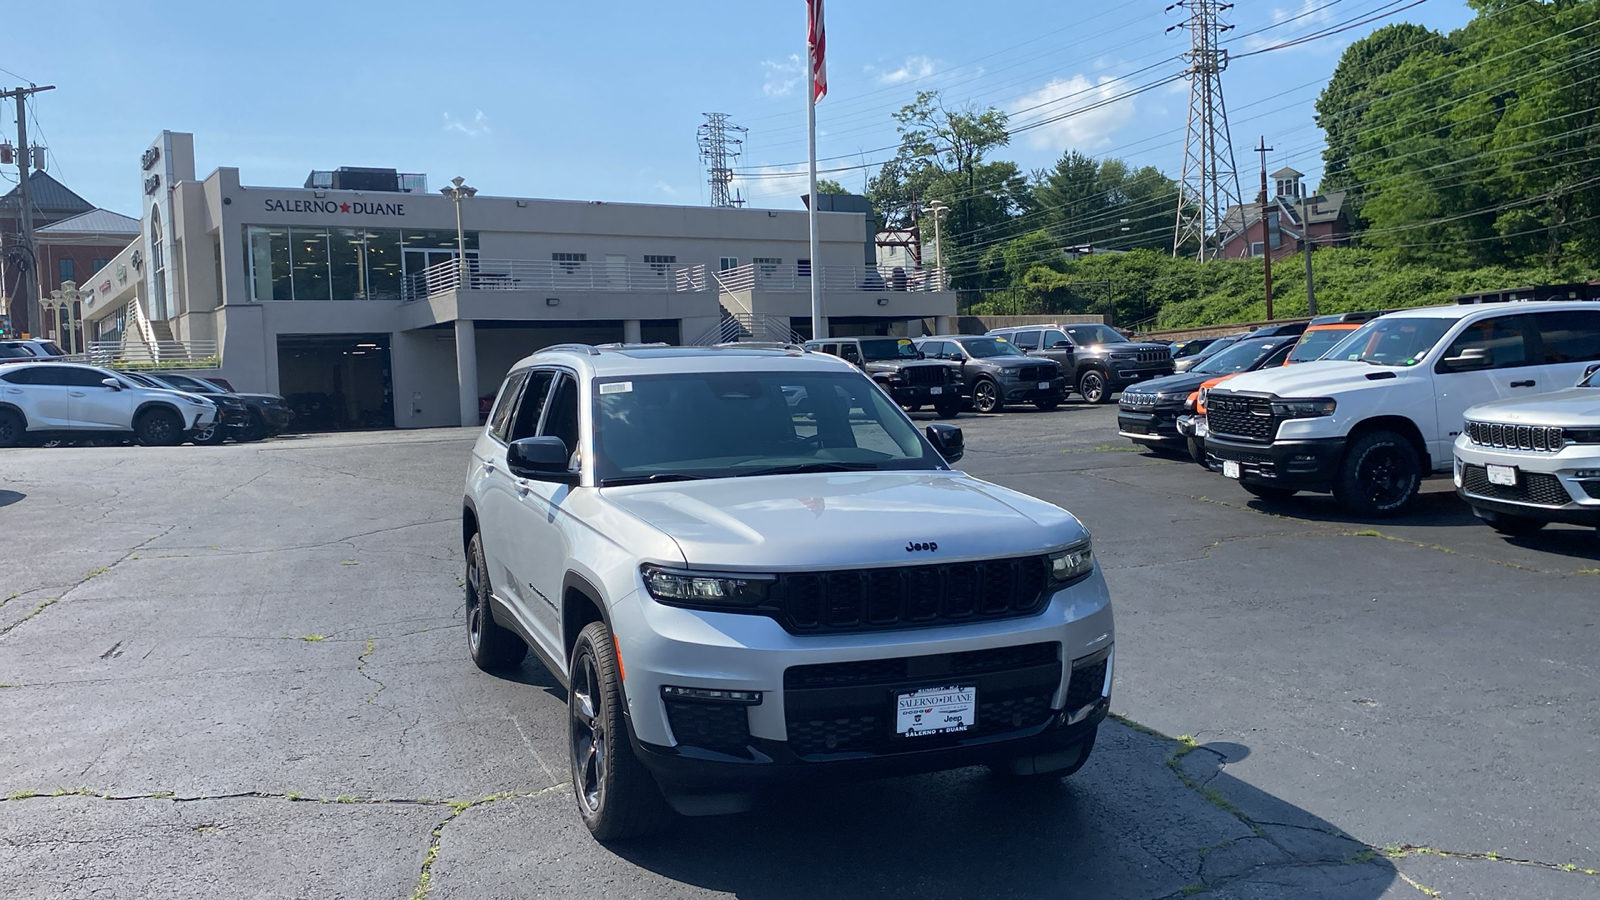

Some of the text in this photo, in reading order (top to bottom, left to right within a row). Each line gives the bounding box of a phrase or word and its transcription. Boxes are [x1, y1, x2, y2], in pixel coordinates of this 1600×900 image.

[265, 199, 405, 215] SALERNO DUANE
[905, 541, 938, 552] Jeep
[900, 694, 973, 708] SALERNO DUANE
